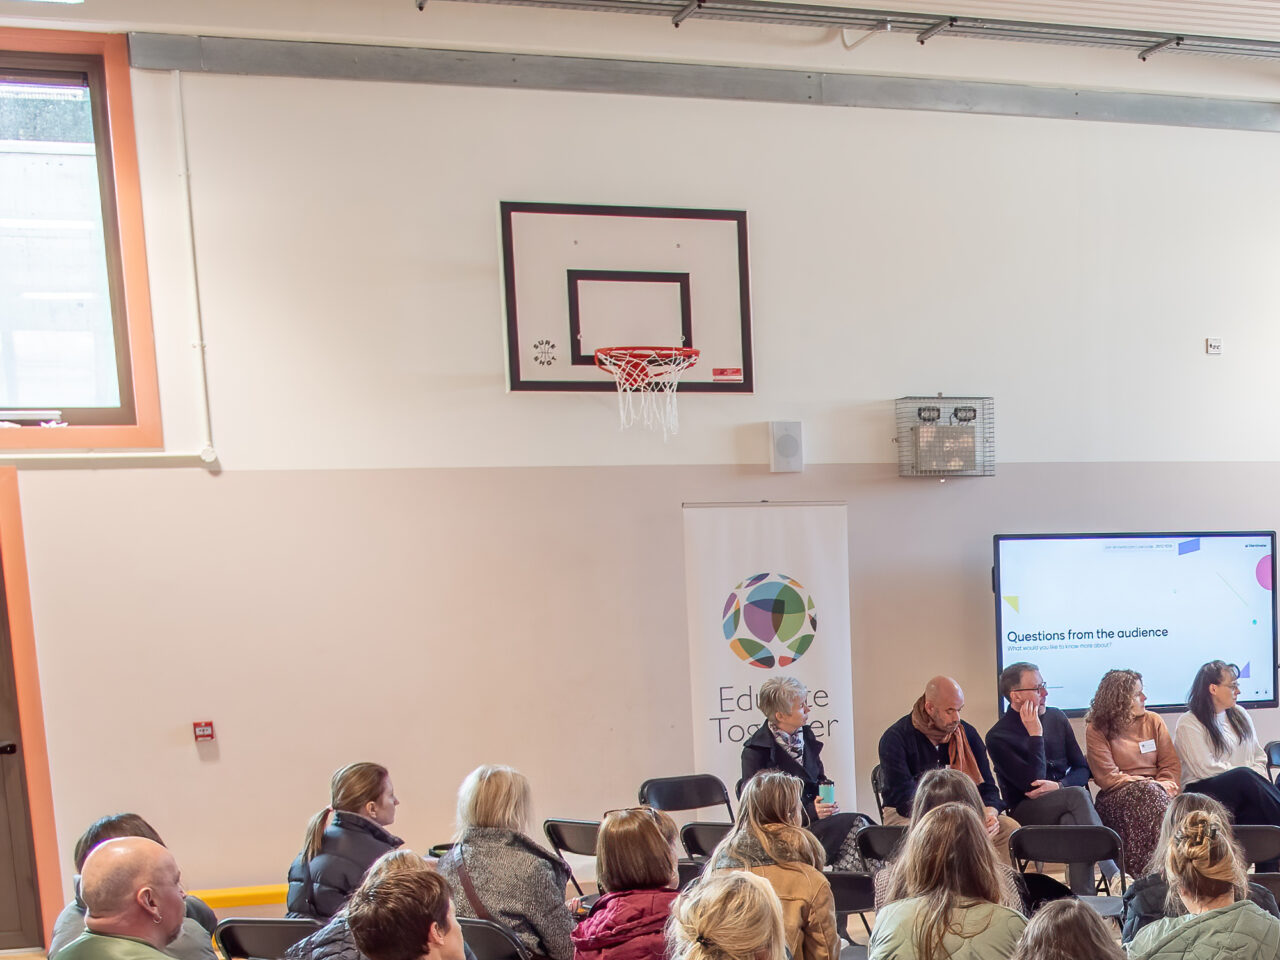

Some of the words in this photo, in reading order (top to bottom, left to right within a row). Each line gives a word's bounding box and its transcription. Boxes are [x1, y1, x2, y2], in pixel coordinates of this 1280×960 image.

[533, 339, 556, 350] SURE
[533, 355, 557, 366] SHOT
[1007, 629, 1066, 644] Questions
[1068, 628, 1094, 640] from
[1096, 628, 1115, 640] the
[1117, 626, 1169, 639] audience
[1094, 641, 1112, 649] about?
[719, 685, 829, 713] Edte
[709, 717, 839, 744] Toer
